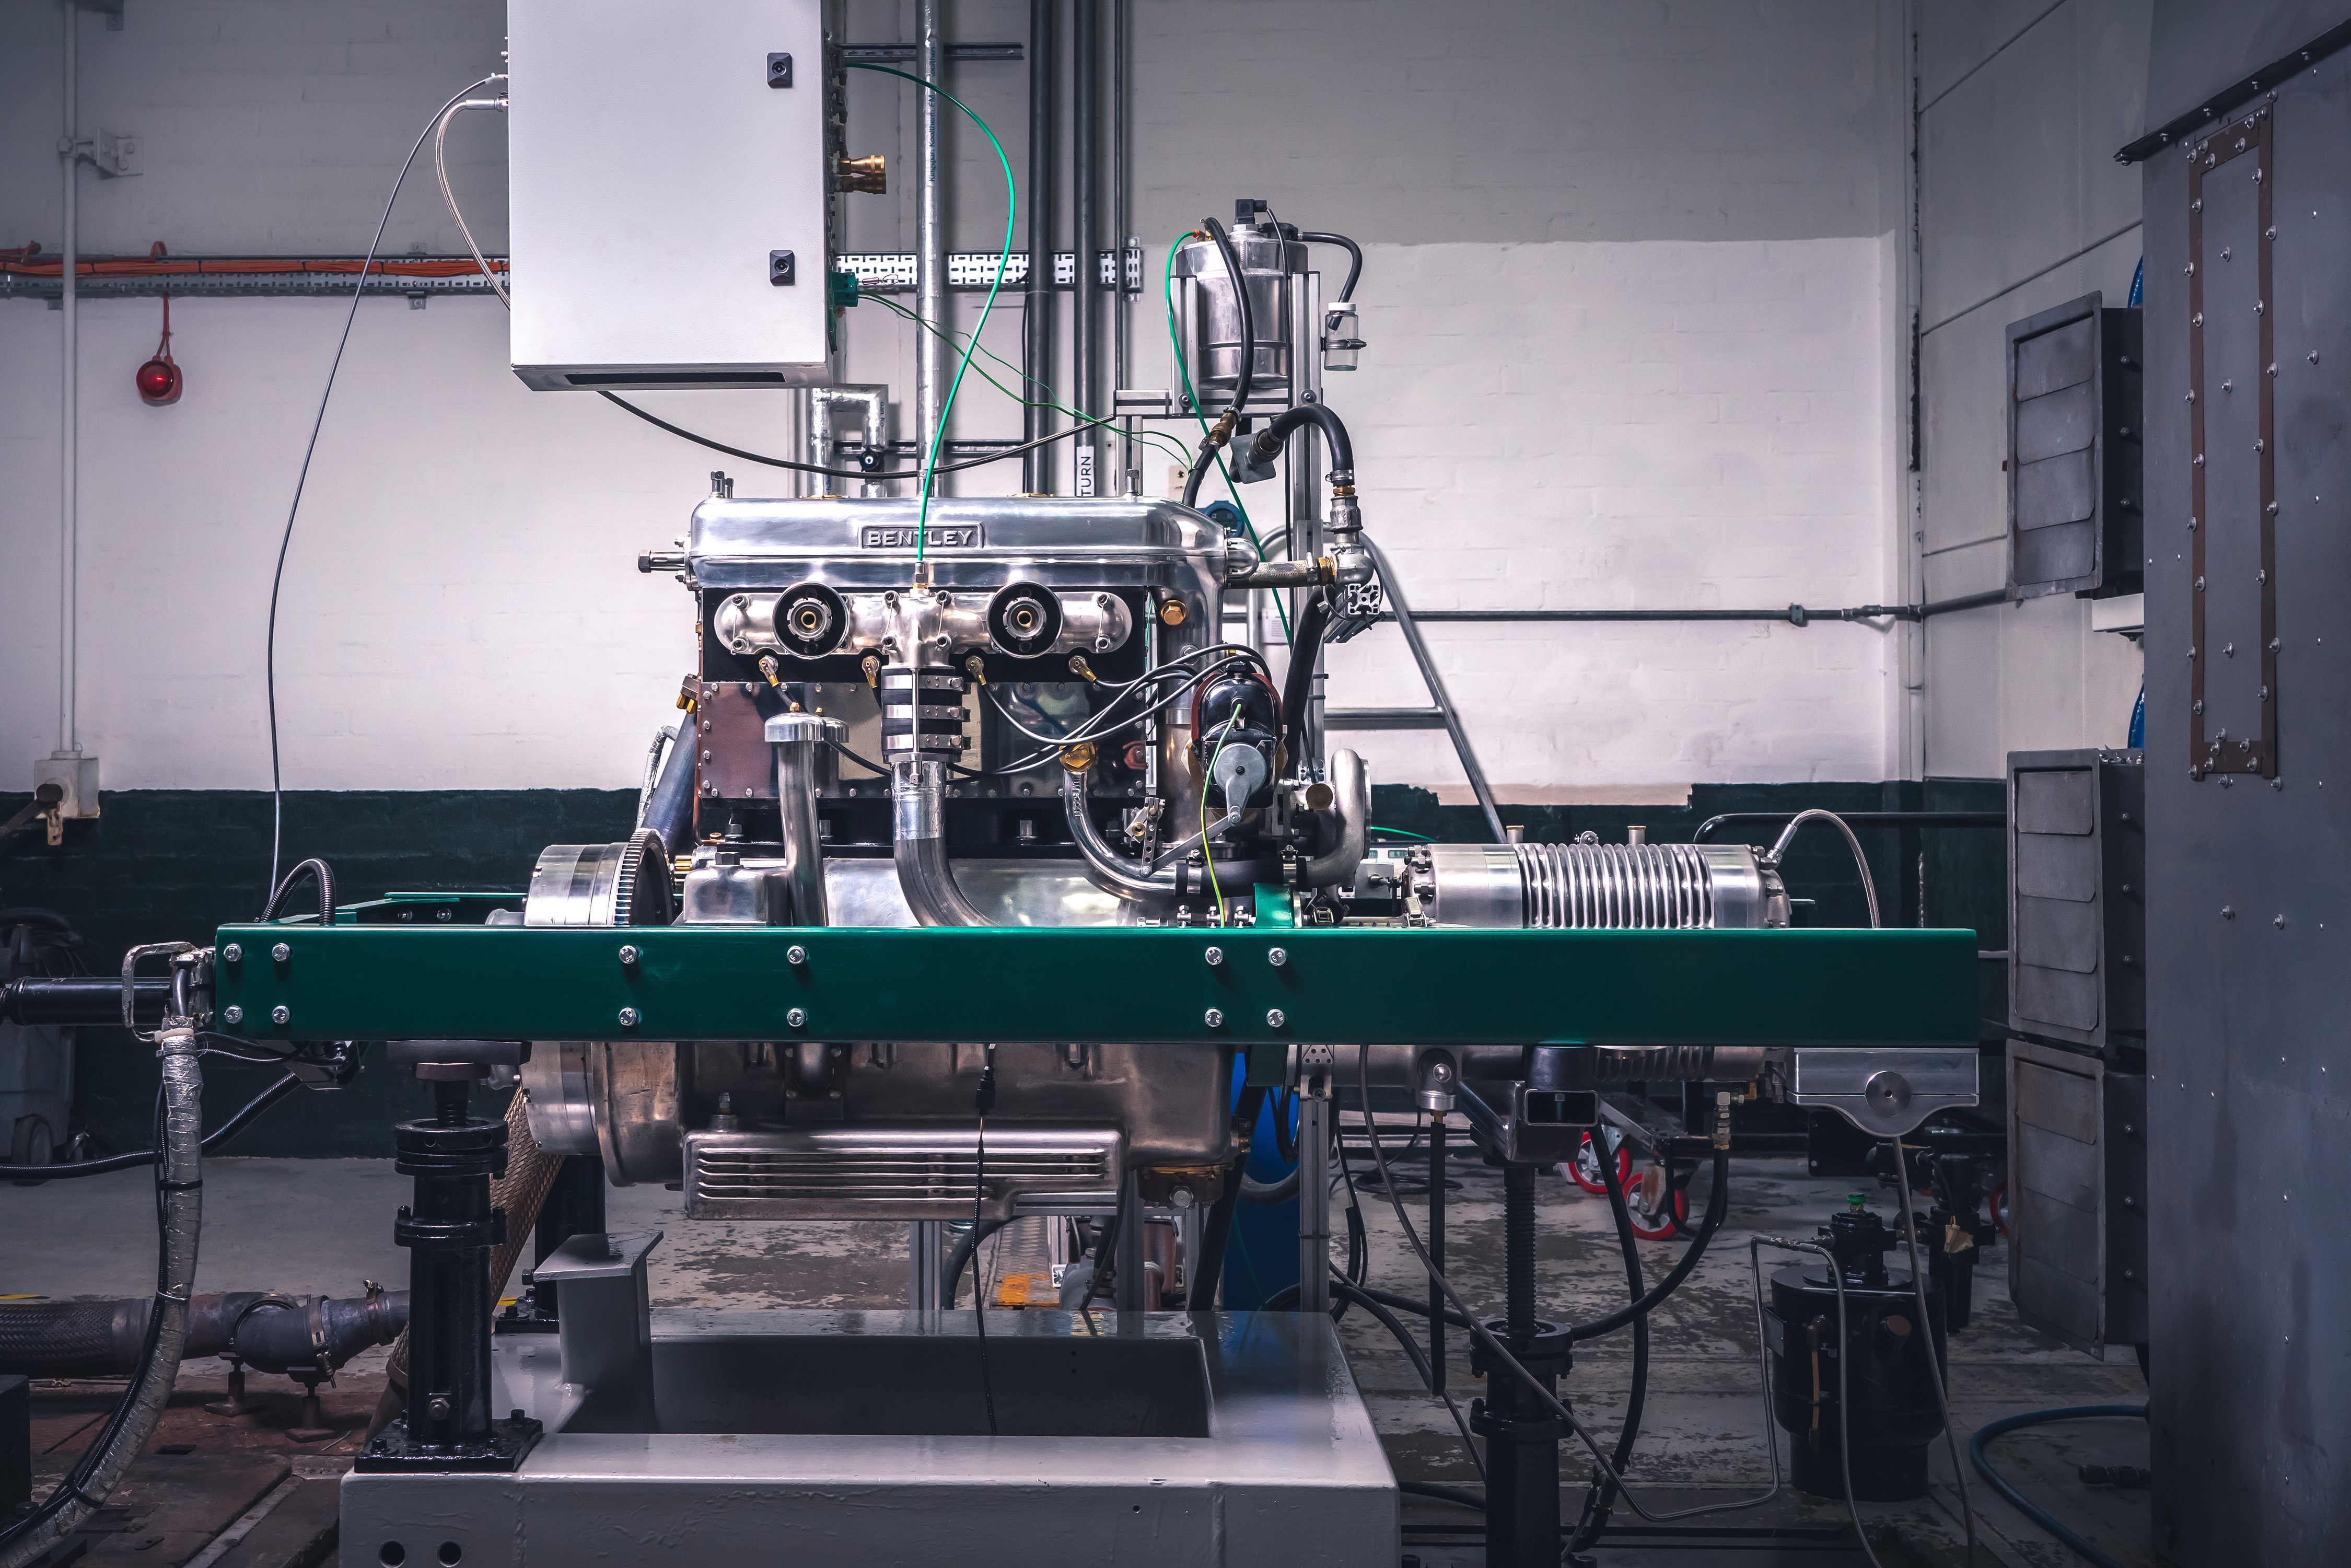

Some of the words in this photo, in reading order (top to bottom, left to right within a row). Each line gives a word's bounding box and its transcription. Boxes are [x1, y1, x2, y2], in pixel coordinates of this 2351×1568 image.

[928, 94, 935, 108] FM
[928, 149, 937, 182] Kingspan
[1081, 457, 1091, 496] TURN
